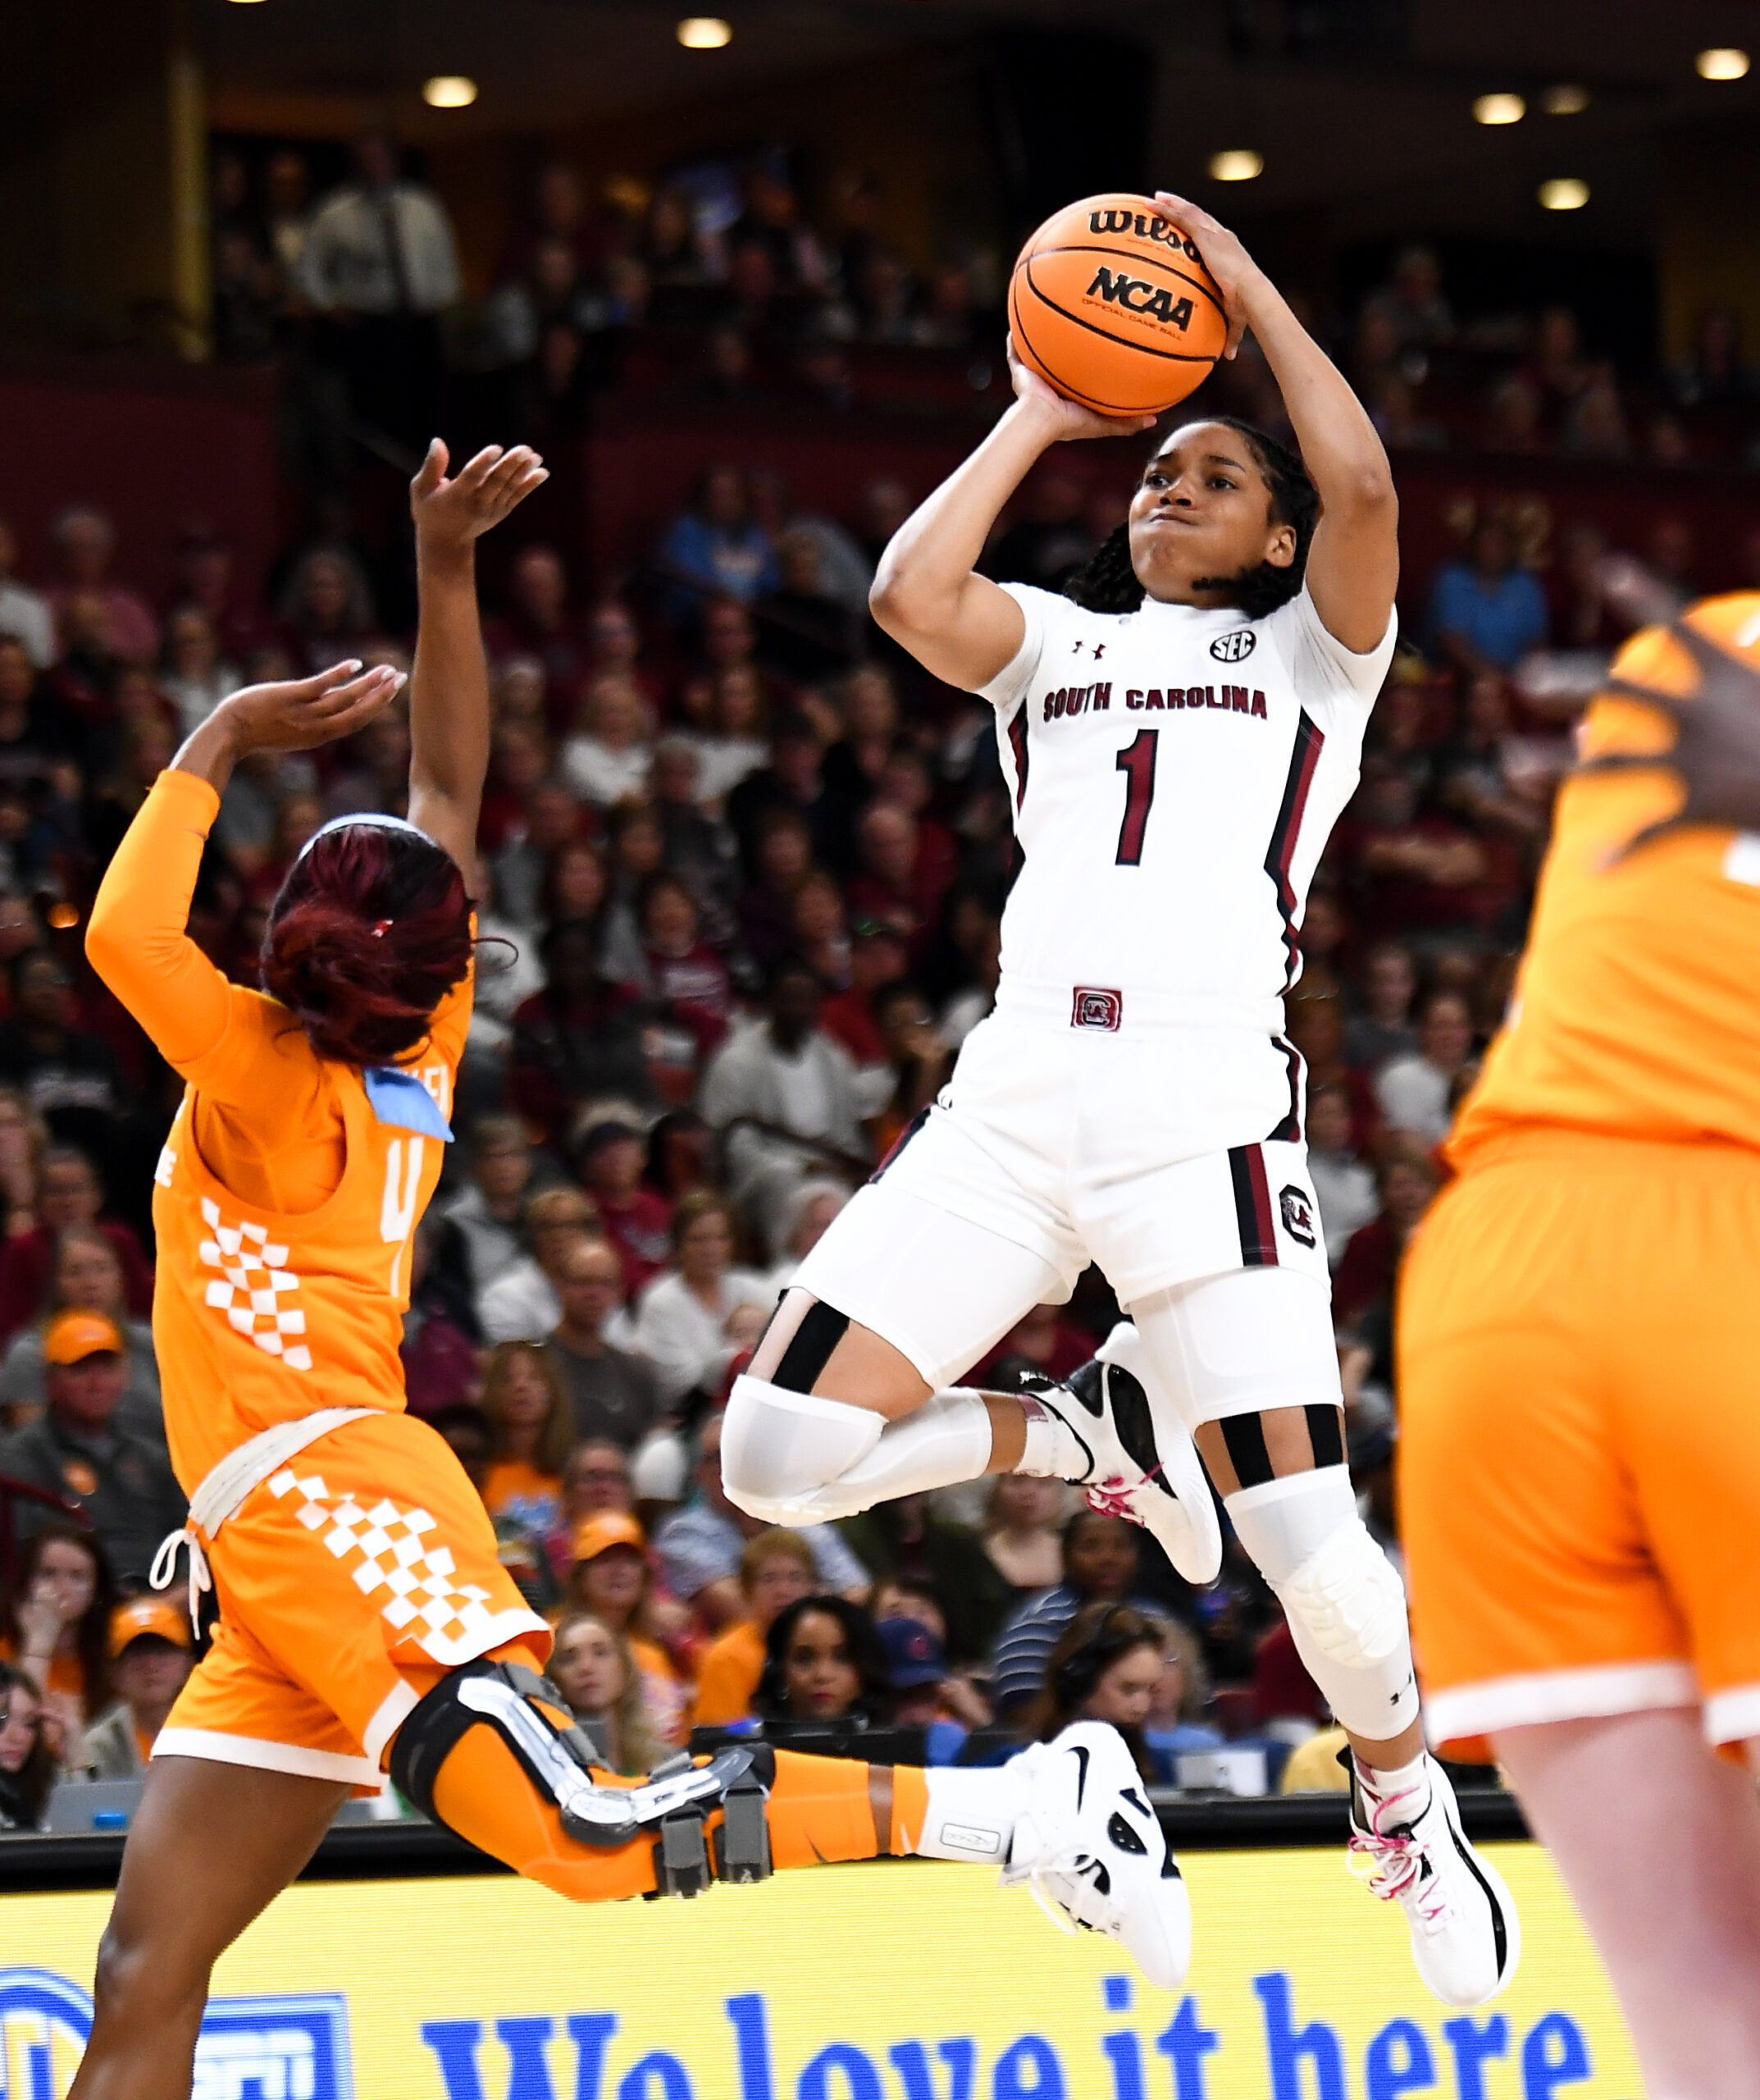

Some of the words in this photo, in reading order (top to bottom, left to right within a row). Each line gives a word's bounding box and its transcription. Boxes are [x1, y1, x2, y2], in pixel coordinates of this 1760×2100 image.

[1088, 210, 1208, 274] Wilso
[1082, 298, 1127, 319] OFFICIAL
[1128, 314, 1157, 330] GAME
[1159, 326, 1183, 341] BALL
[1086, 266, 1195, 332] NCAA
[1211, 631, 1253, 661] SEC
[1043, 682, 1112, 723] SOUTH
[1125, 685, 1268, 721] CAROLINA
[1115, 728, 1160, 867] 1
[1102, 1974, 1220, 2100] it
[1252, 1971, 1592, 2100] here
